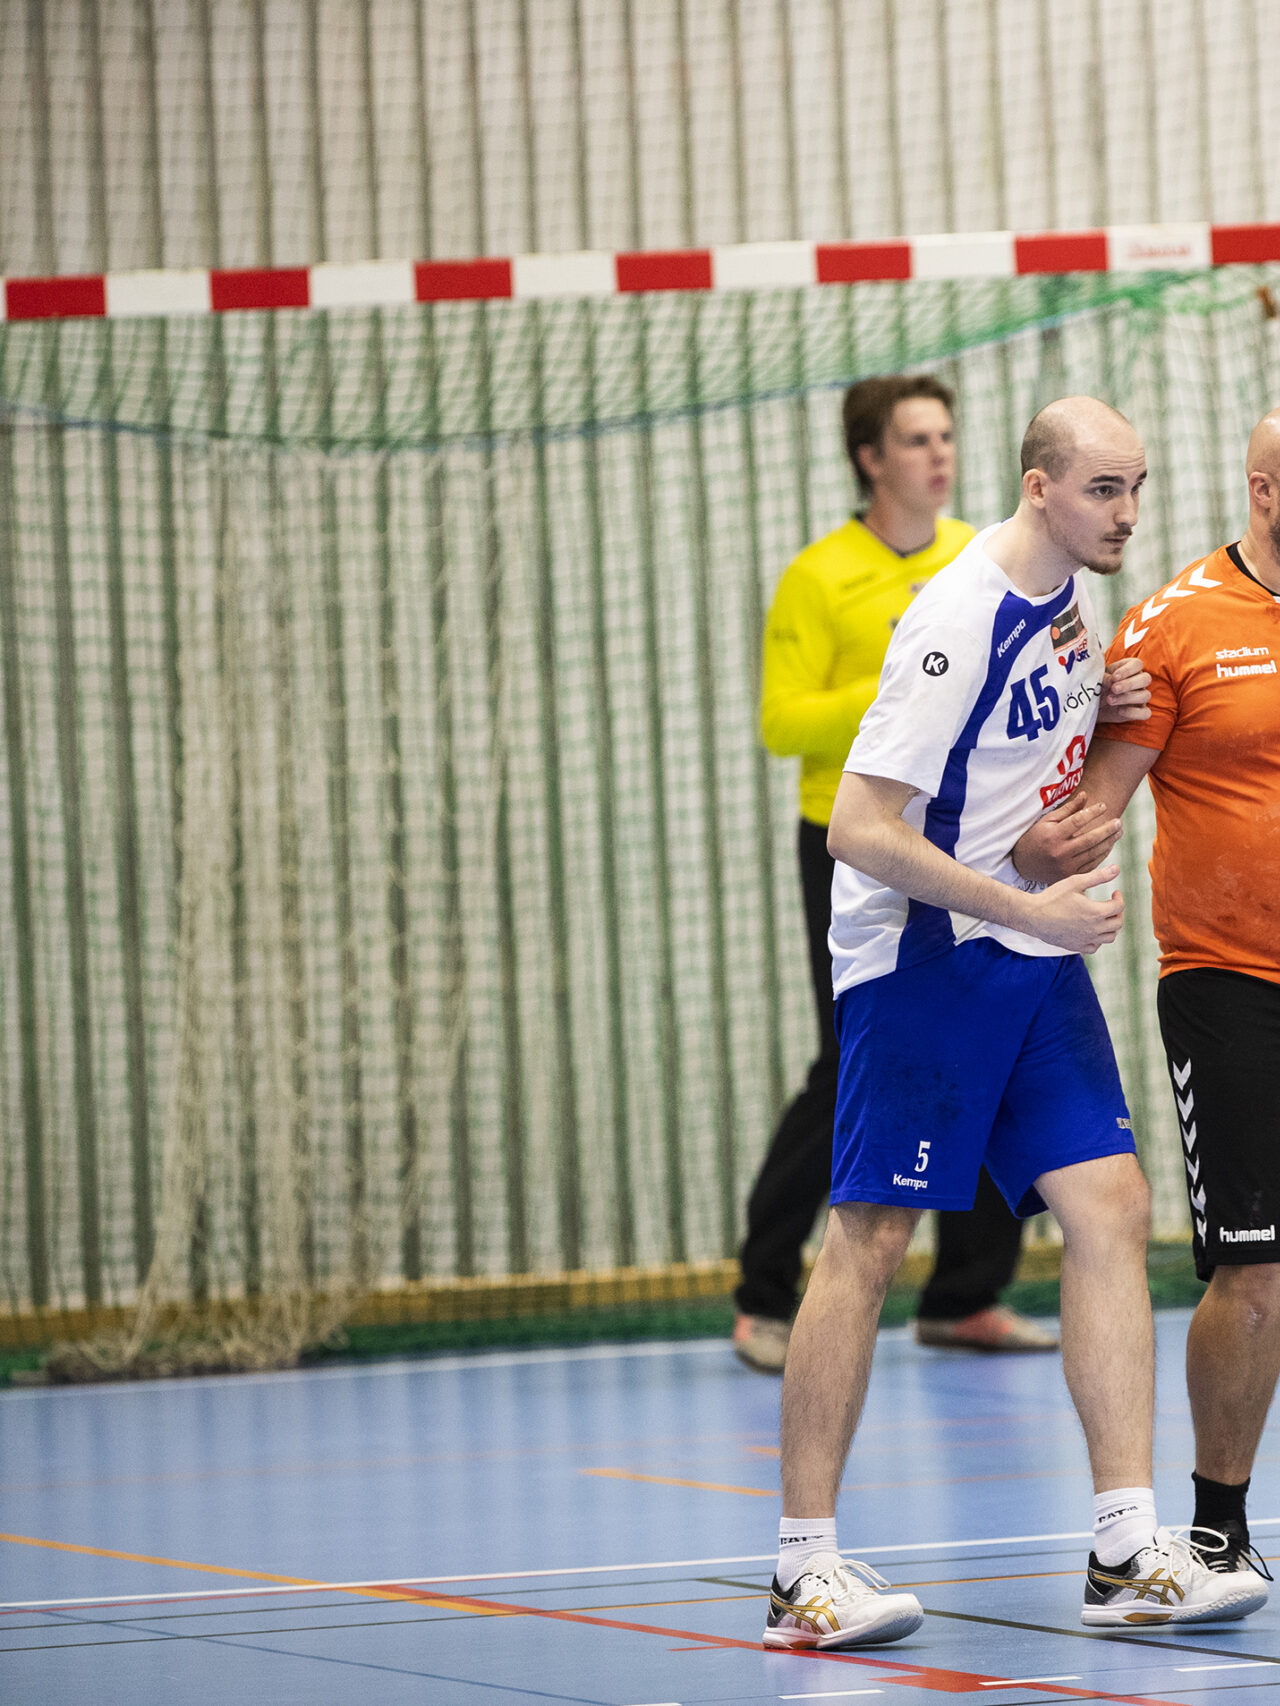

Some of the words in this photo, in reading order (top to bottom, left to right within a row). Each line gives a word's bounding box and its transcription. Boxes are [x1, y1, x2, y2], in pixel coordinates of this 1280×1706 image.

[997, 619, 1026, 658] Kempa
[1216, 646, 1269, 660] stadium
[1216, 660, 1277, 679] hummel
[1006, 664, 1060, 741] 45
[914, 1140, 931, 1172] 5
[892, 1173, 928, 1190] Kempa
[1220, 1225, 1275, 1242] hummel
